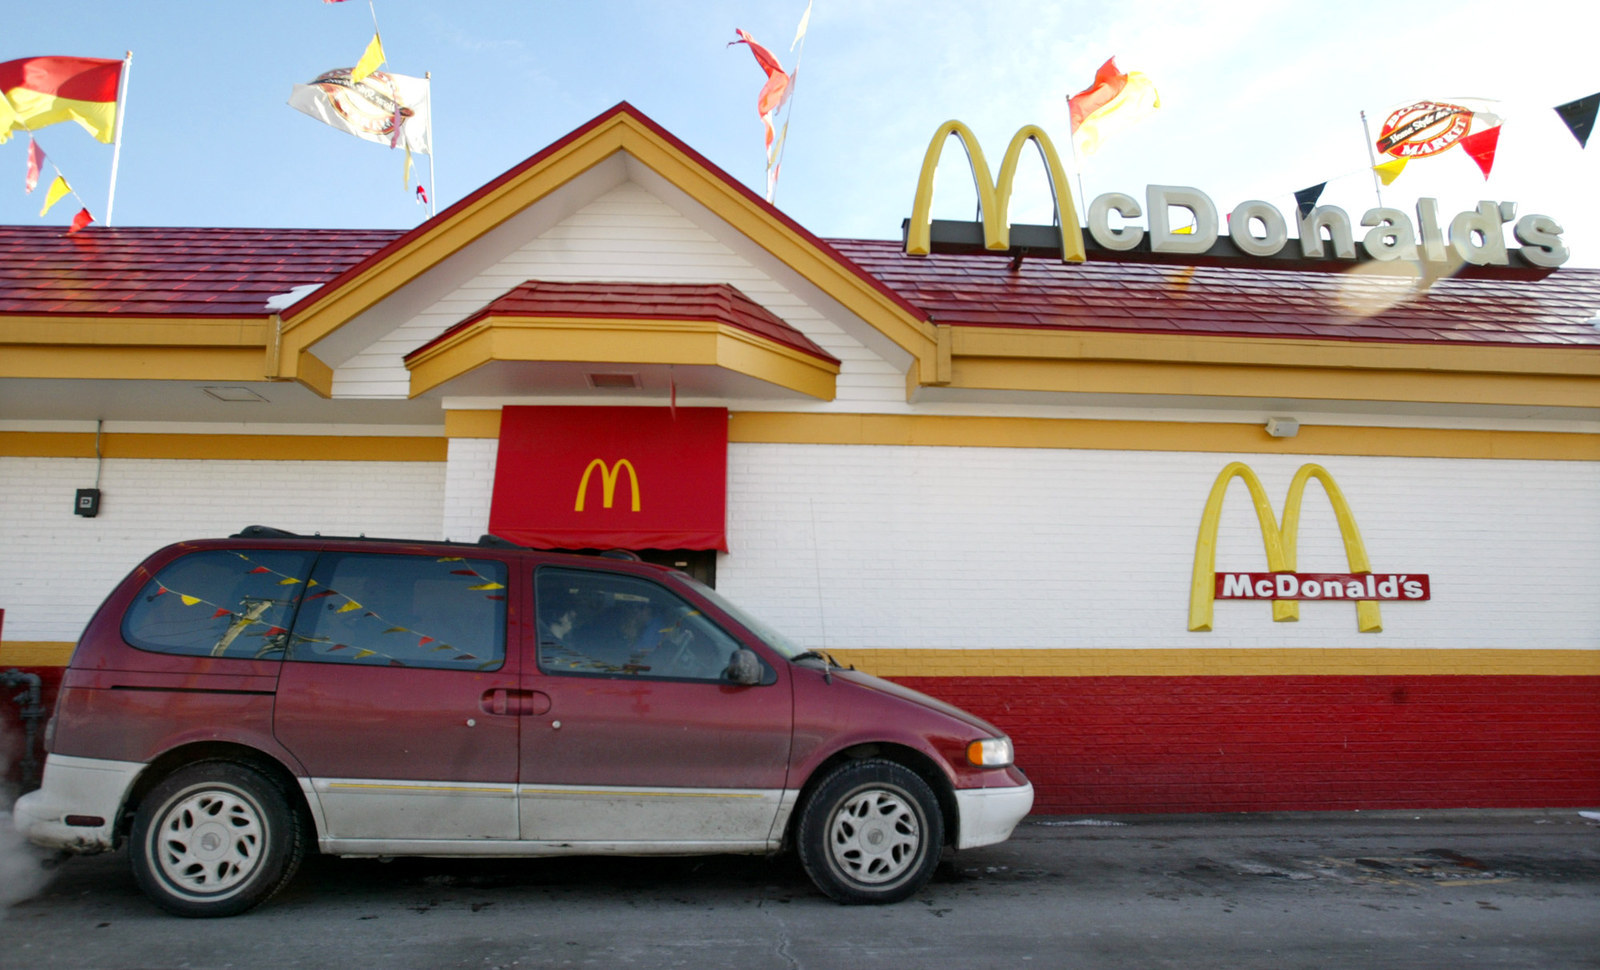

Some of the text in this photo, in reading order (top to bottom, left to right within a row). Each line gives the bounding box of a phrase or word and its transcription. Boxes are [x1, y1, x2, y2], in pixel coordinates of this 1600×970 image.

[1390, 127, 1414, 144] Home
[1401, 117, 1467, 155] MARKET
[1222, 573, 1424, 599] McDonald's
